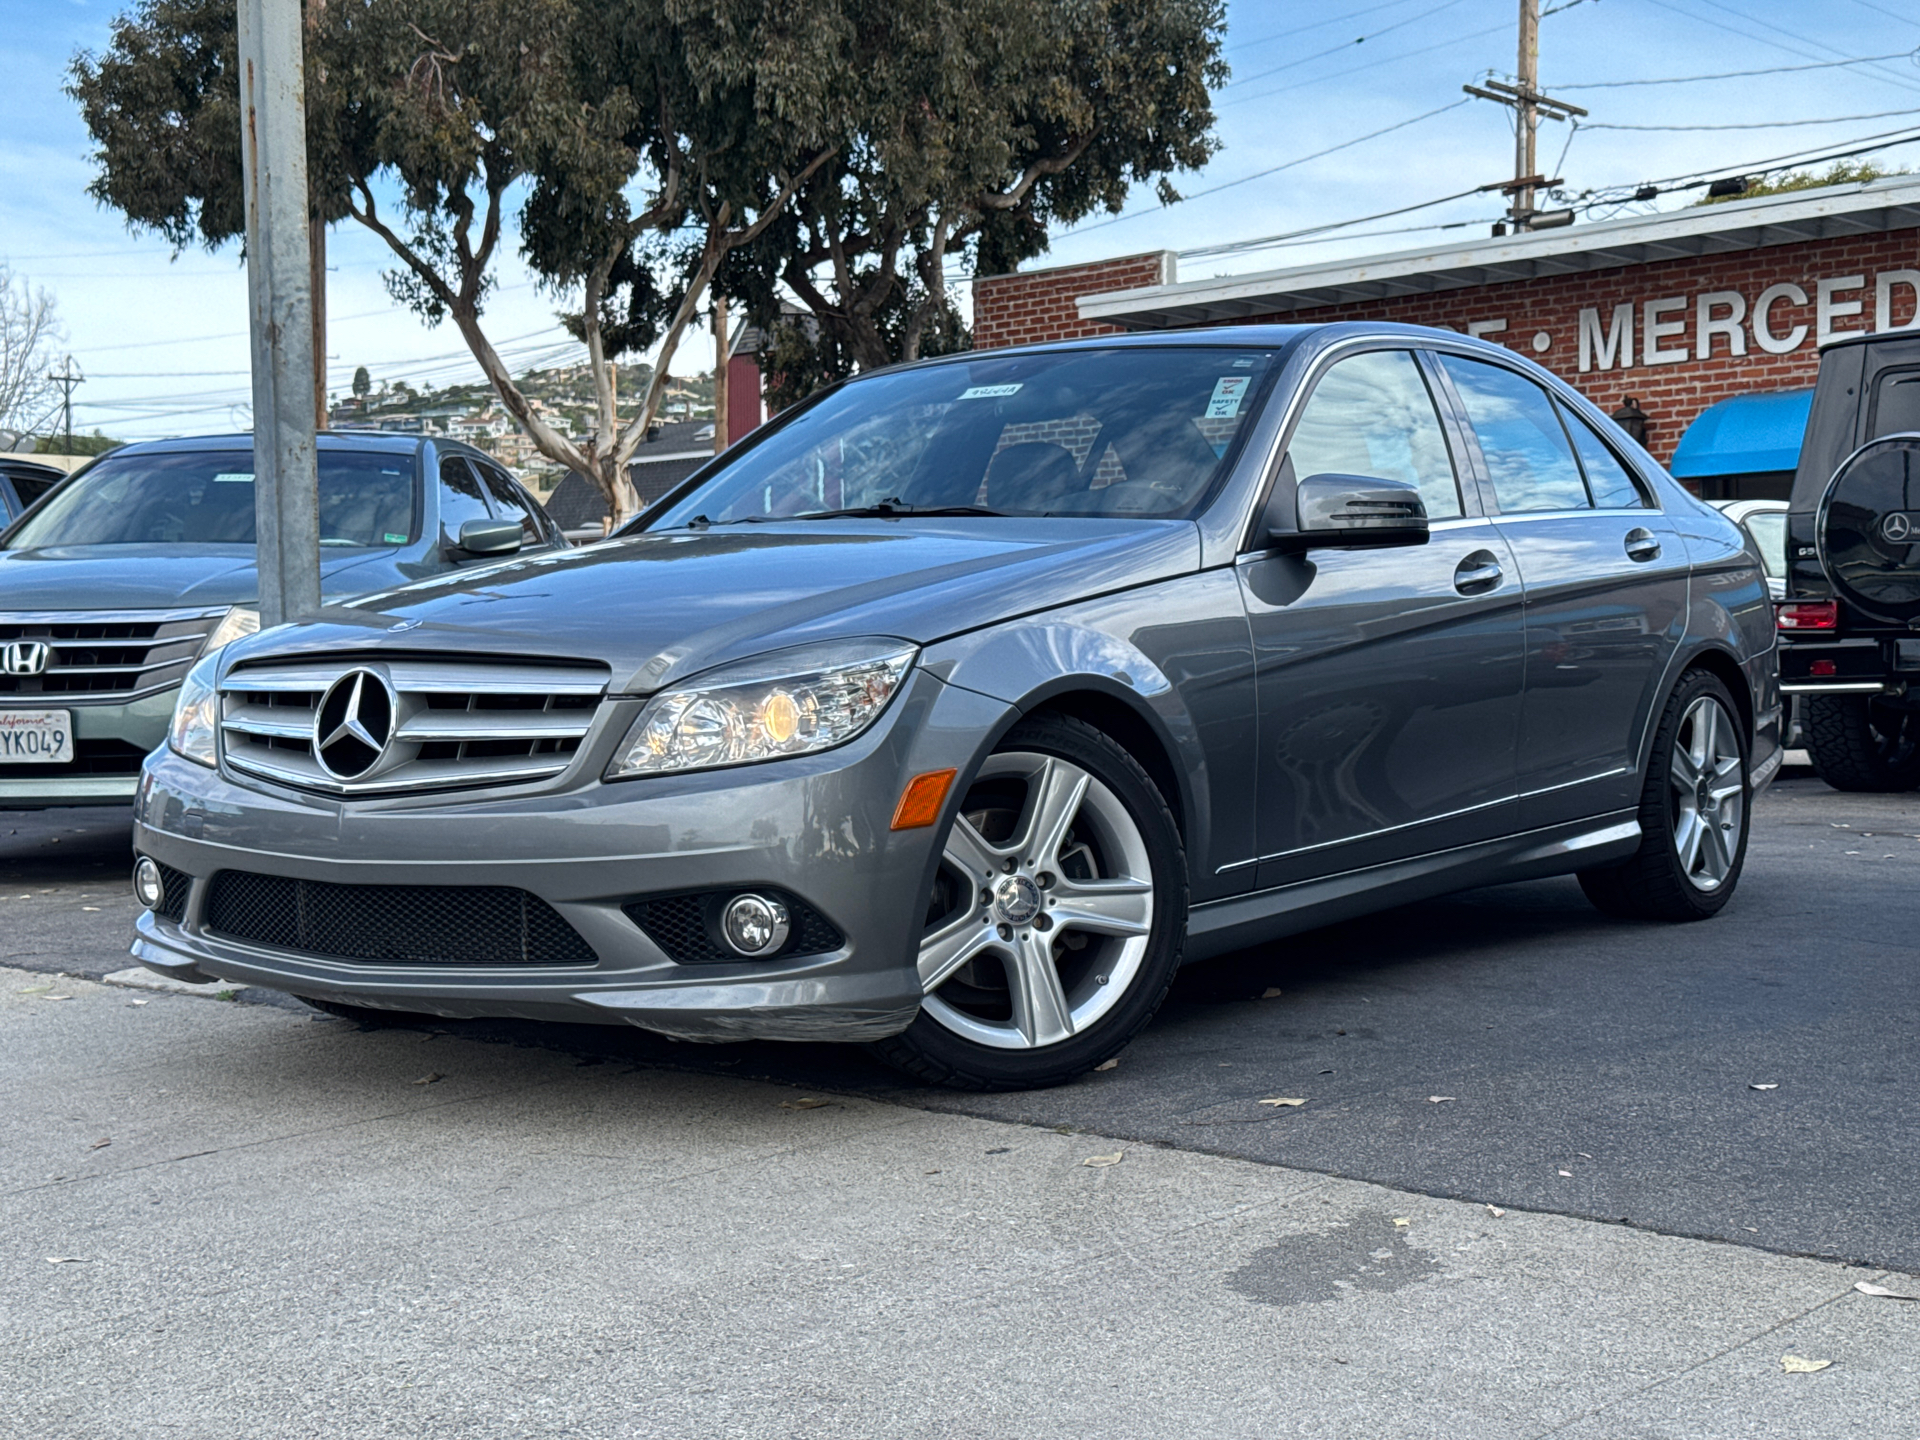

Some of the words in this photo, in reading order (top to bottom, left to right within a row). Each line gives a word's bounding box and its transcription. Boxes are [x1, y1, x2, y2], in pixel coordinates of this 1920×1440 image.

[1578, 269, 1920, 373] MERCED
[1798, 547, 1816, 556] G5
[0, 730, 65, 755] YK049
